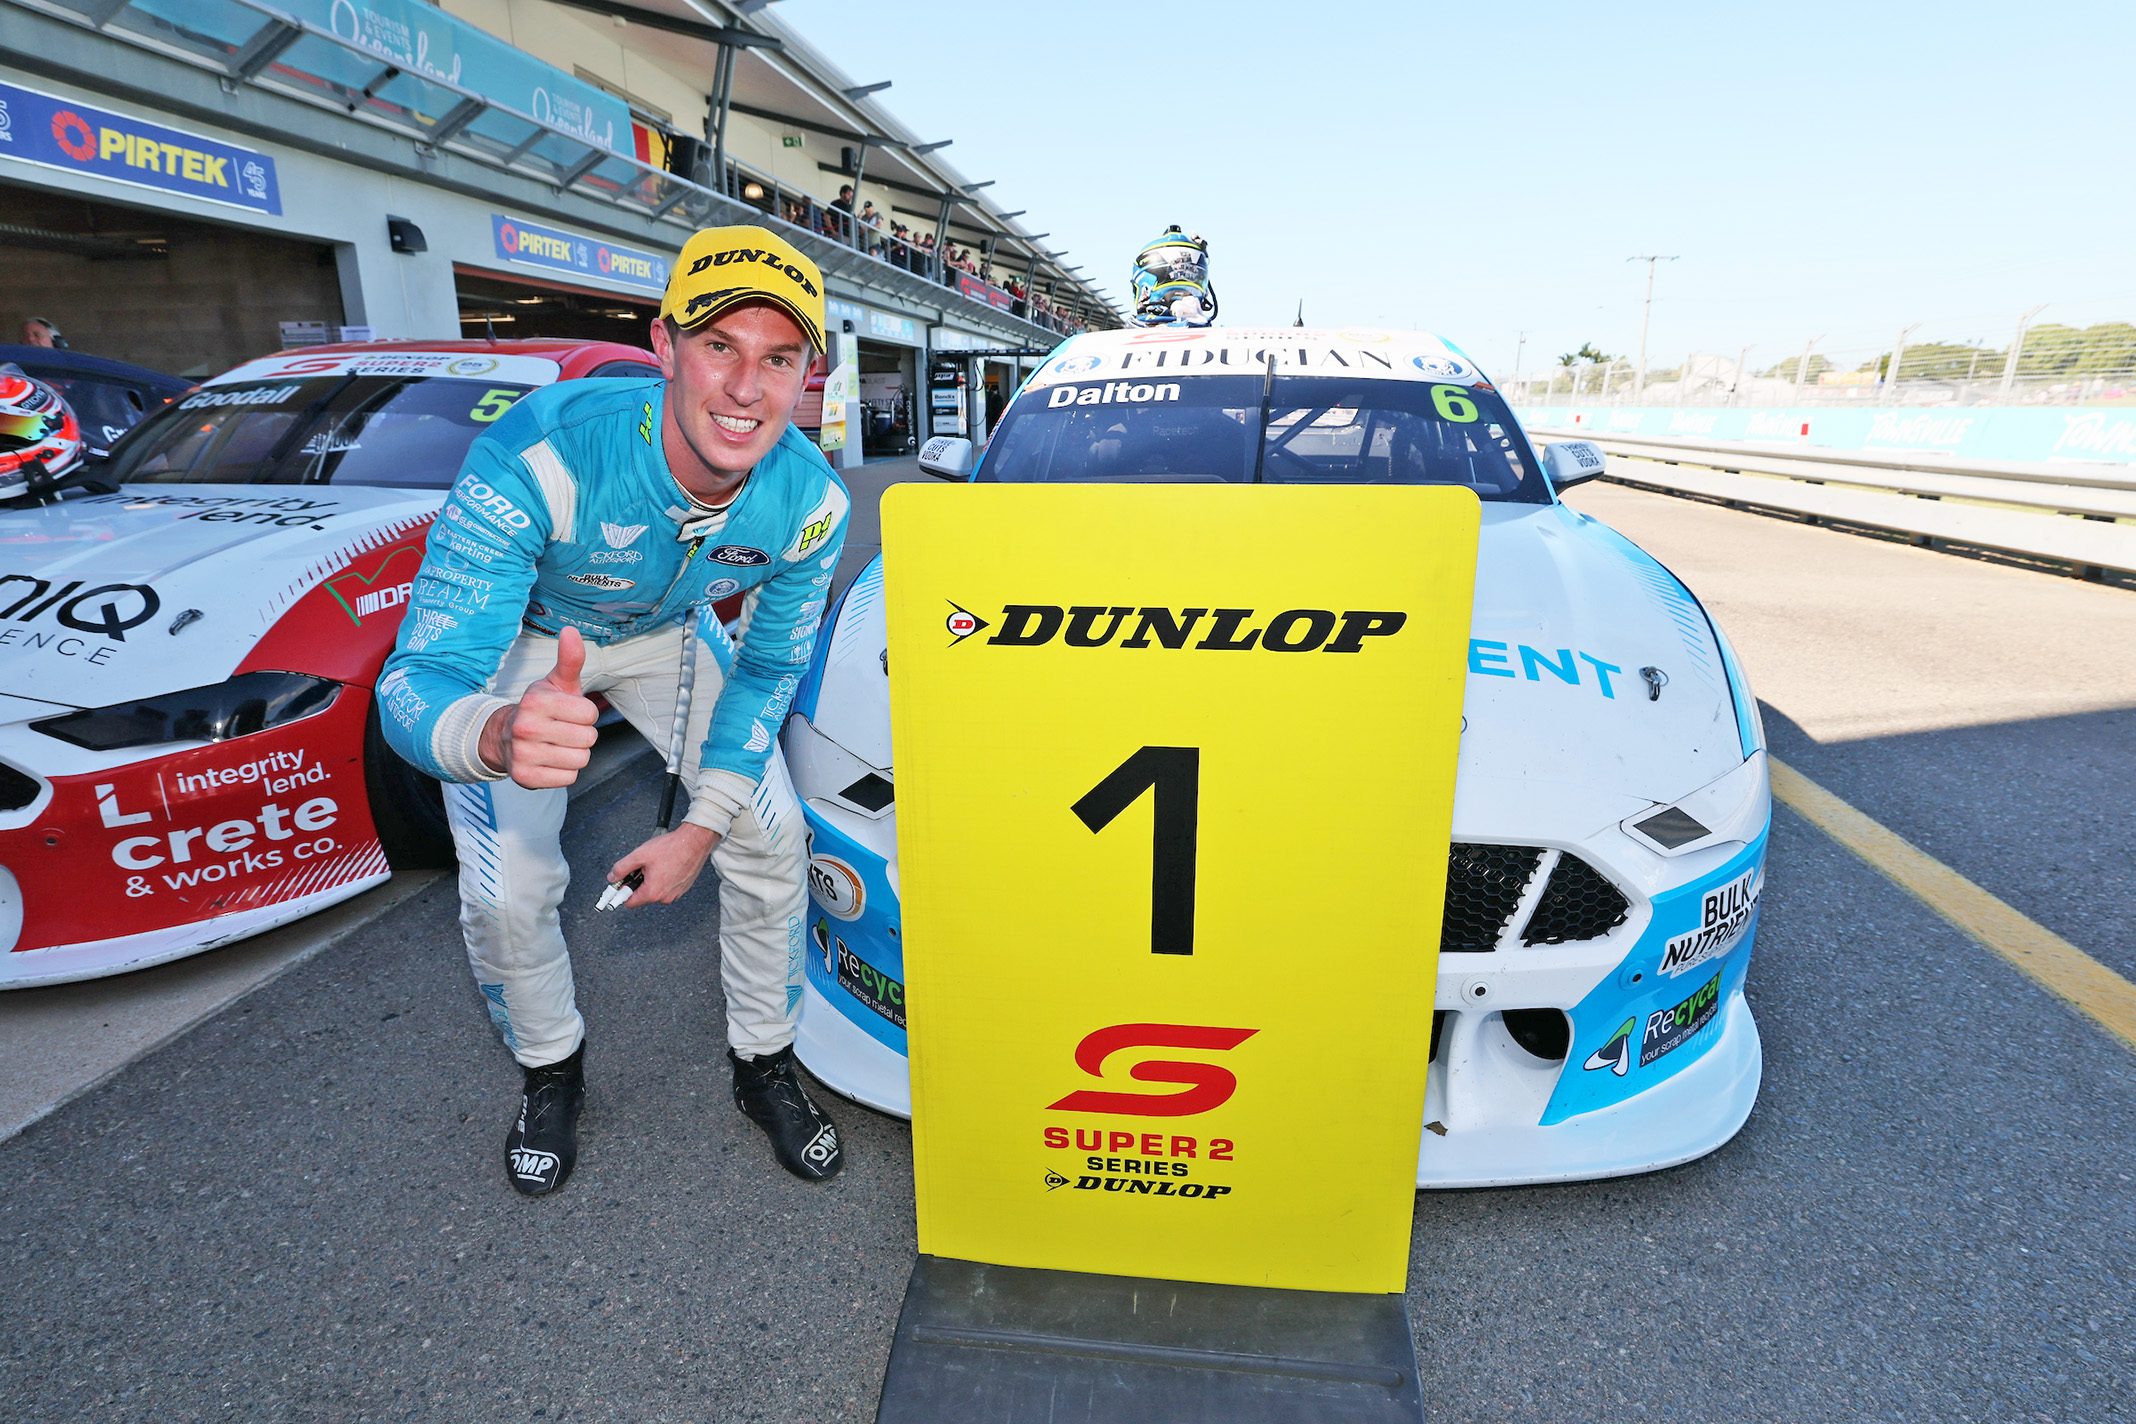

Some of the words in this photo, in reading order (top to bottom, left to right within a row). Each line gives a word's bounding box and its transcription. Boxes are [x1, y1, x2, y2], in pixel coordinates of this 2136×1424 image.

[100, 127, 229, 188] PIRTEK
[518, 230, 572, 262] PIRTEK
[611, 253, 652, 279] PIRTEK
[687, 249, 818, 298] DUNLOP
[1120, 348, 1393, 370] FIDUCIAN
[178, 385, 302, 411] Goodall
[469, 389, 521, 423] 5
[1047, 381, 1181, 409] Dalton
[1430, 384, 1480, 424] 6
[1865, 411, 1974, 445] TOWNSVILLE
[454, 487, 518, 537] PERFORMANCE
[458, 473, 532, 529] FORD
[179, 508, 337, 532] lend.
[449, 538, 493, 564] karting
[717, 547, 758, 564] Ford
[416, 578, 491, 611] REALM
[411, 621, 443, 642] CUTS
[414, 606, 459, 630] THREE
[987, 604, 1407, 653] DUNLOP
[176, 748, 305, 794] integrity
[264, 761, 331, 797] lend.
[111, 795, 338, 871] crete
[125, 875, 155, 898] &
[162, 851, 284, 891] works
[292, 836, 343, 860] co.
[1070, 745, 1200, 956] 1
[1704, 873, 1752, 928] BULK
[852, 984, 871, 1006] scrap
[871, 998, 894, 1020] metal
[1640, 1044, 1661, 1066] your
[1660, 1033, 1682, 1054] scrap
[1044, 1127, 1198, 1159] SUPER
[1208, 1138, 1235, 1162] 2
[1086, 1156, 1189, 1178] SERIES
[1073, 1175, 1232, 1200] DUNLOP
